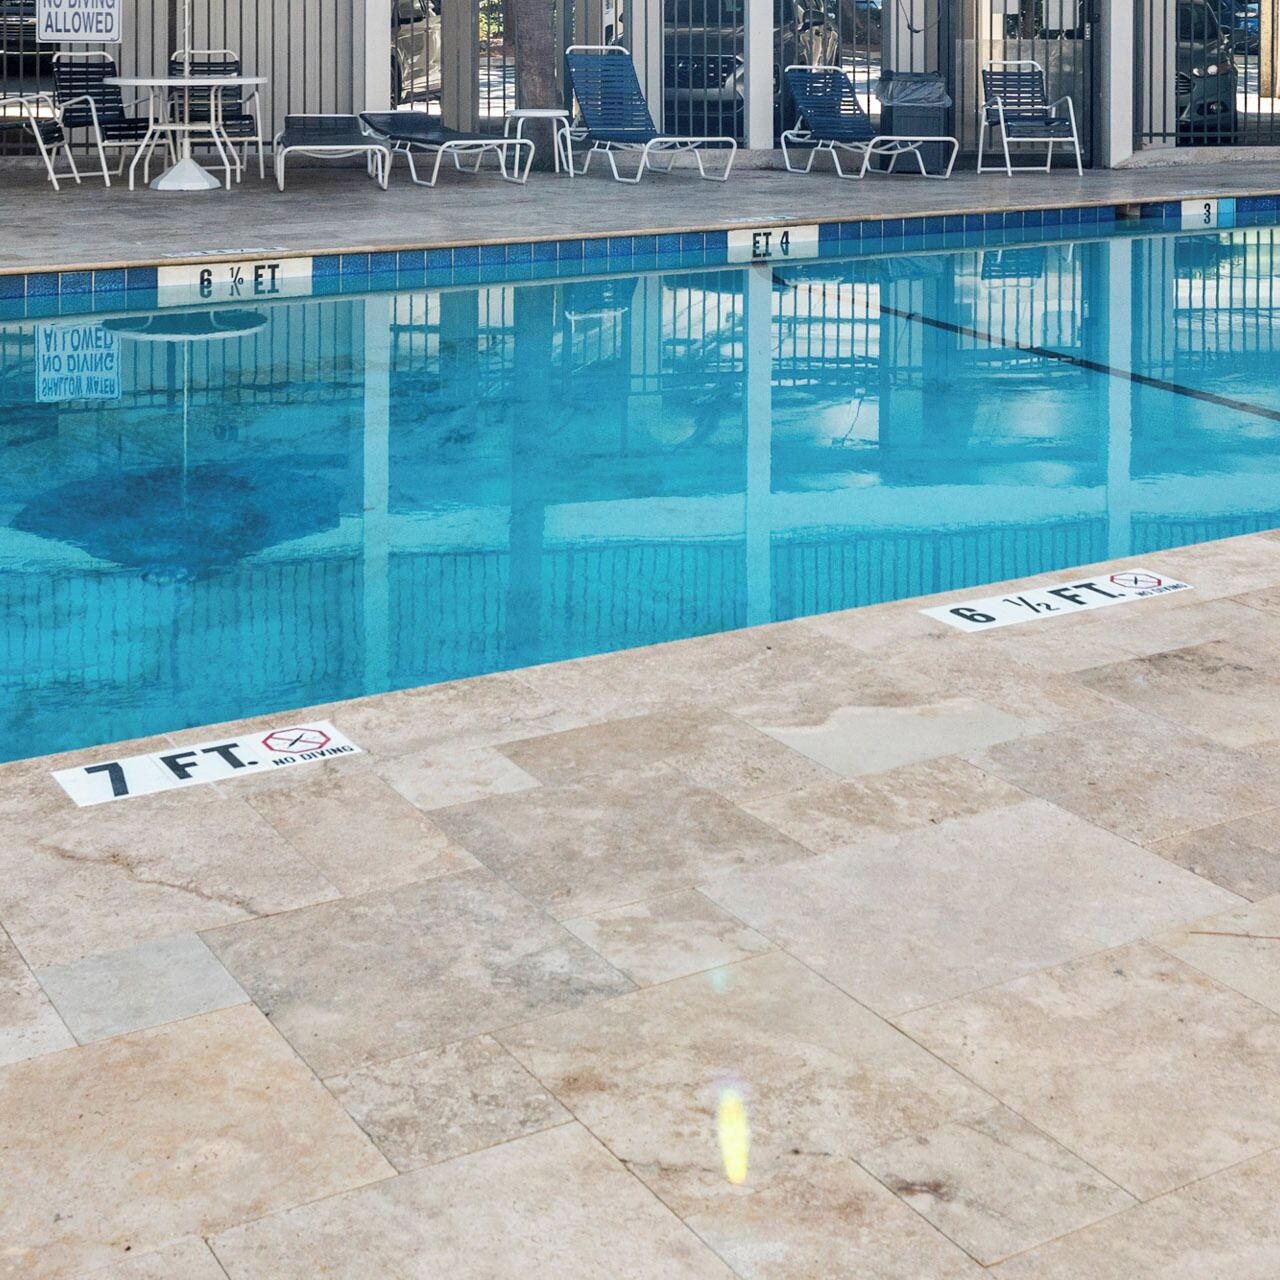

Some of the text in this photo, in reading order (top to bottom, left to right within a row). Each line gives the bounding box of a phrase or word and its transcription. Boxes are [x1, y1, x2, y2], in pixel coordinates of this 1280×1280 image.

[45, 11, 114, 33] ALLOWED
[949, 607, 996, 623] 6
[1047, 582, 1126, 605] FT.
[84, 743, 259, 797] 7 FT.
[272, 744, 356, 767] NO DIVING
